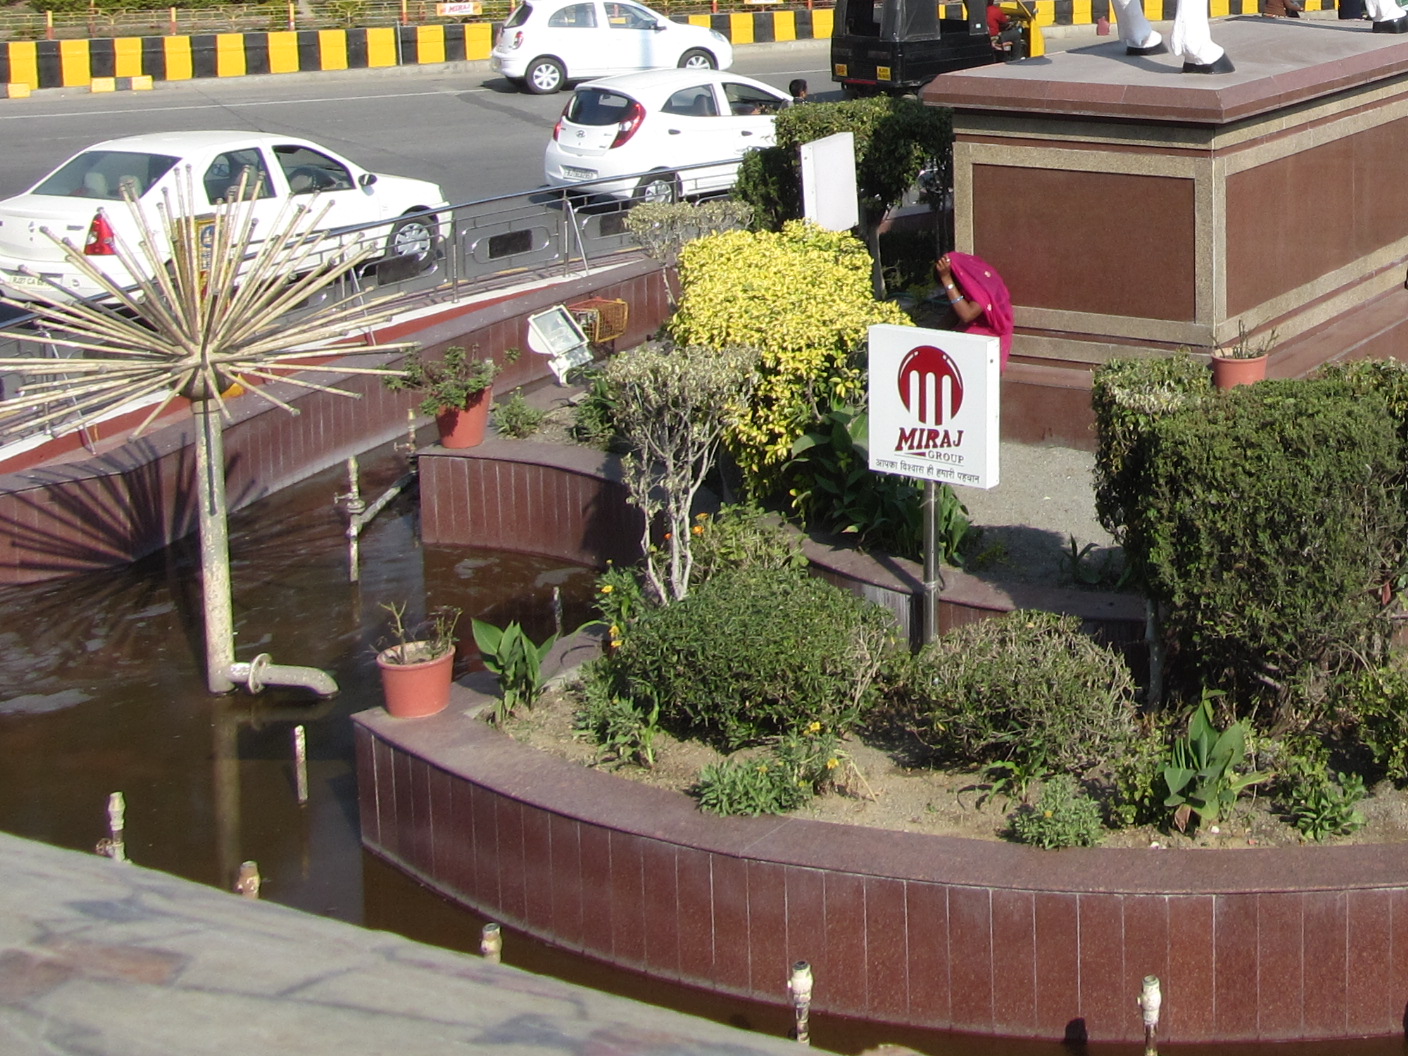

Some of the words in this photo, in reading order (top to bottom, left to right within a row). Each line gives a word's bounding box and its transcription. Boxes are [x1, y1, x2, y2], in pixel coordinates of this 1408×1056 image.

[448, 4, 471, 13] MIRAJ
[894, 427, 964, 452] MIRAJ
[928, 450, 964, 464] GROUP
[876, 458, 898, 470] आपका
[900, 459, 925, 474] विश्वास
[927, 464, 934, 477] ही
[936, 467, 955, 480] हमारी
